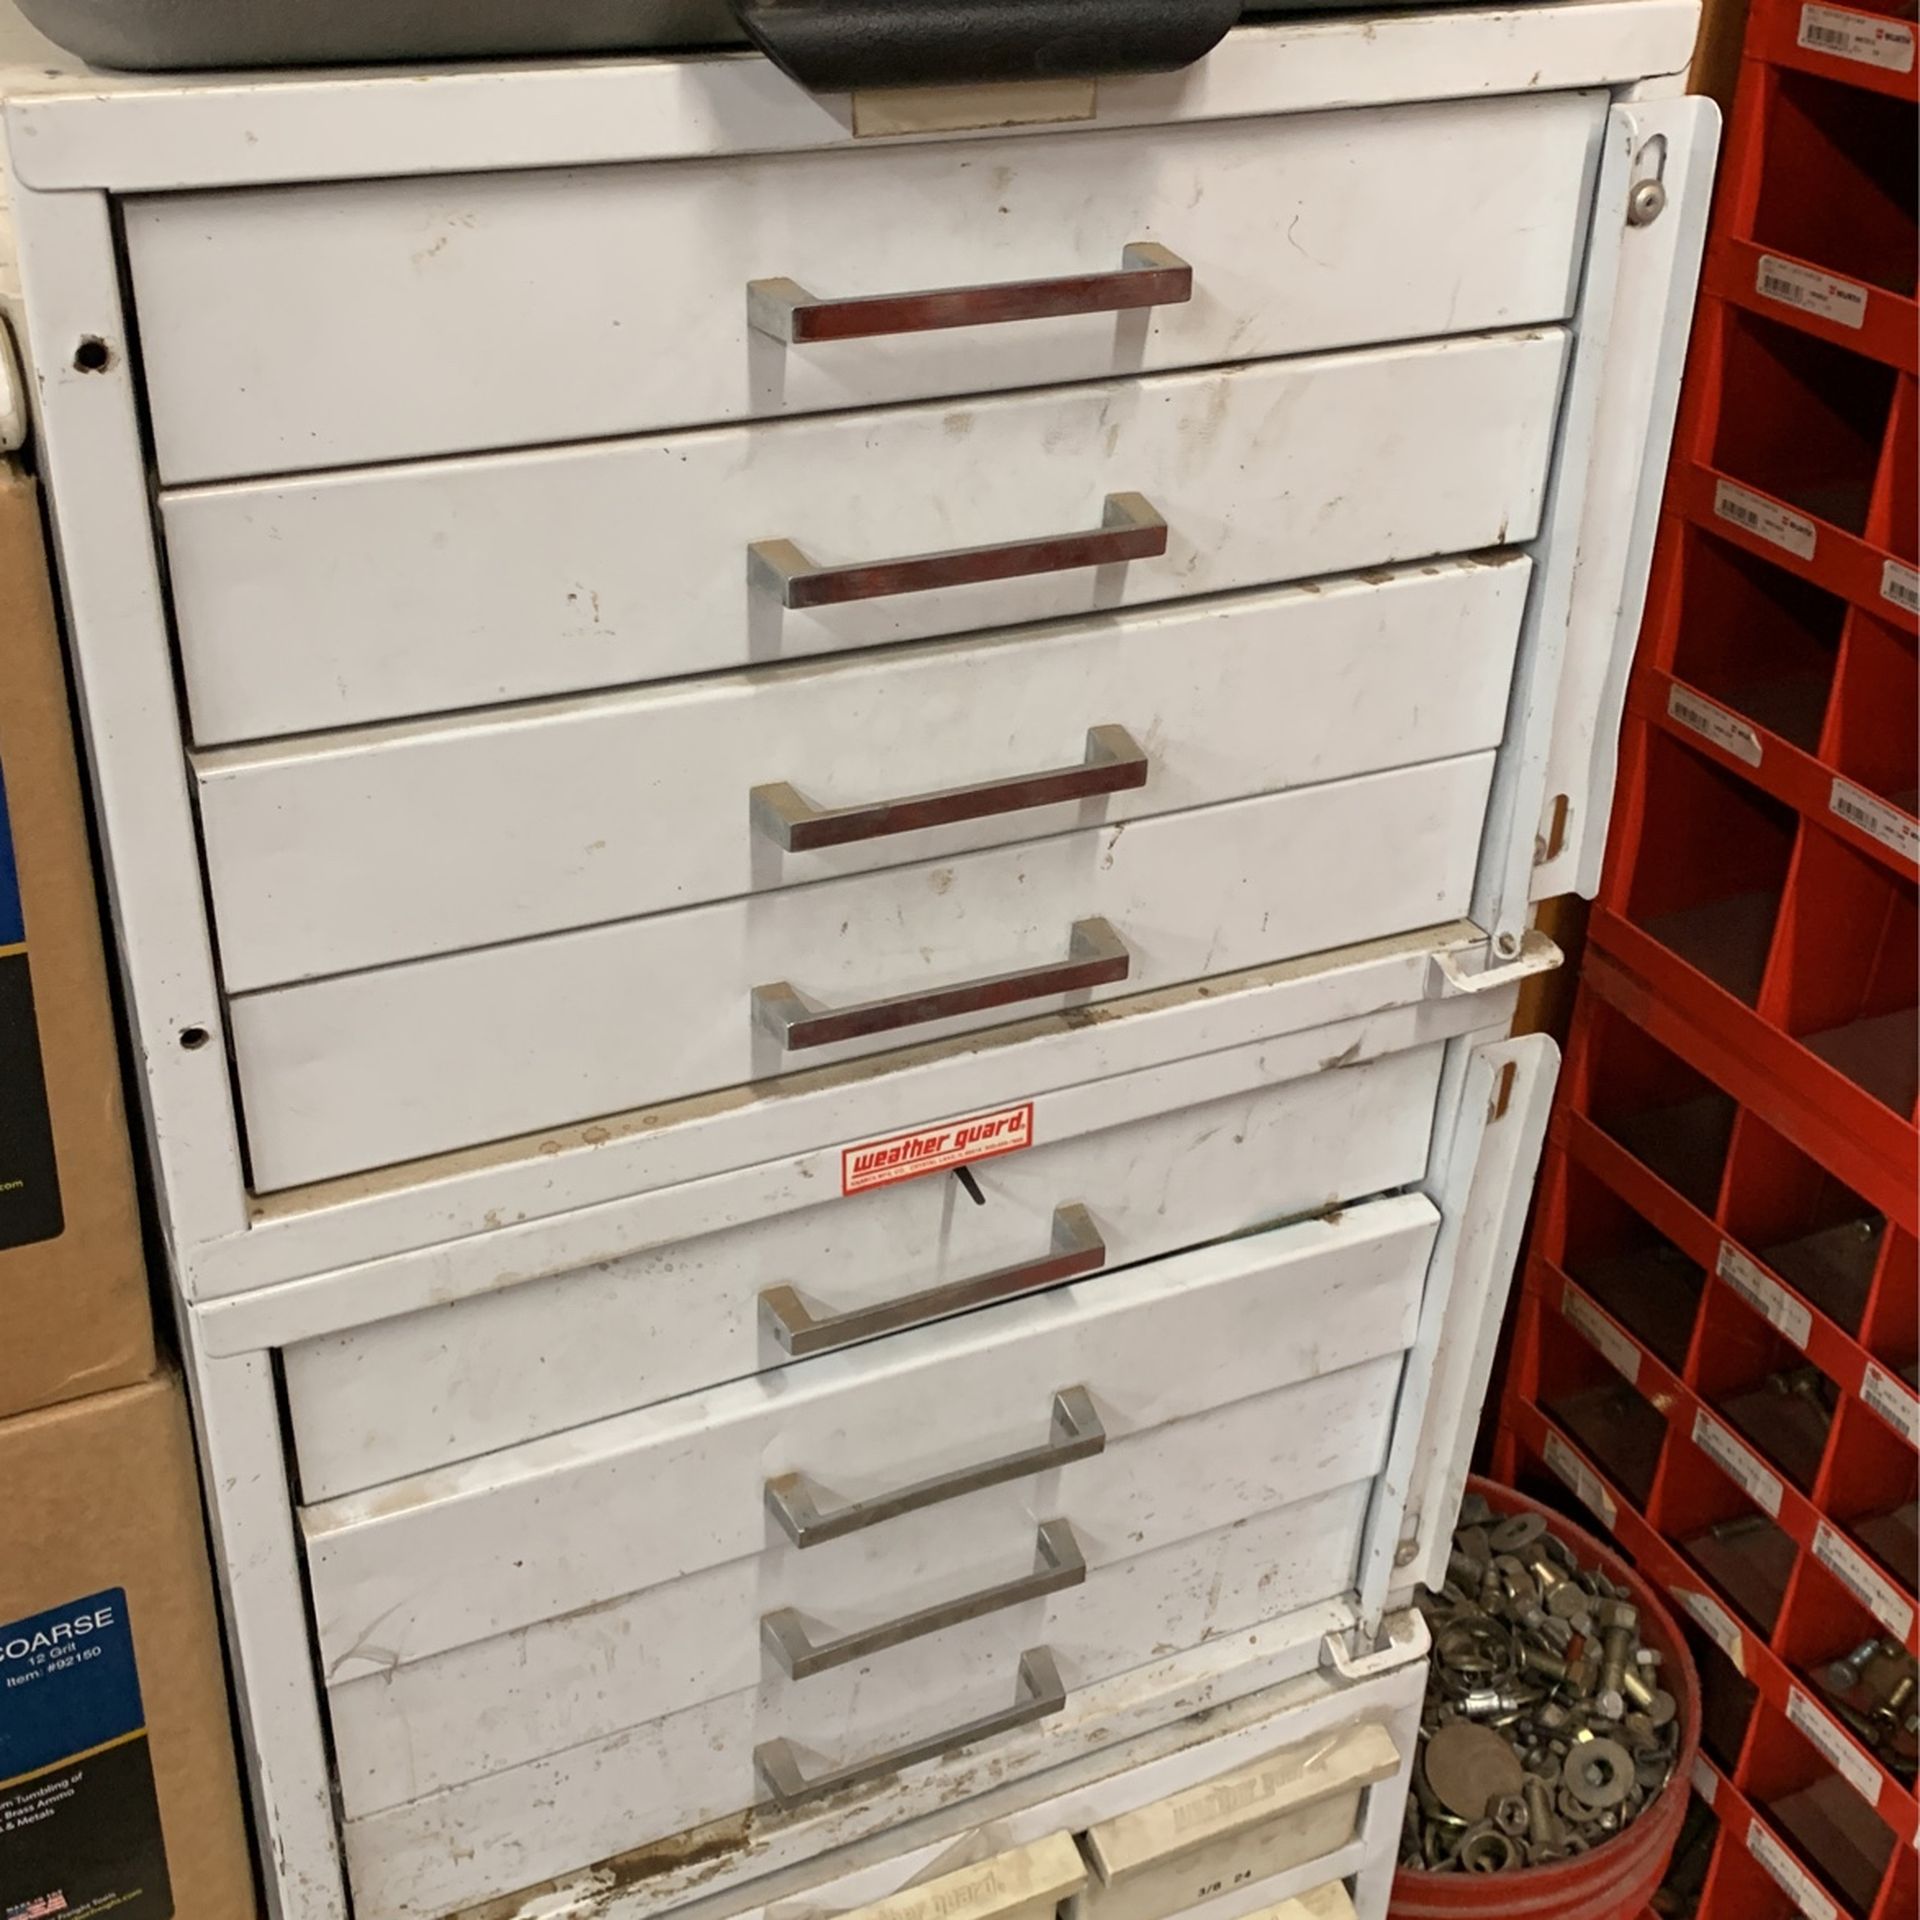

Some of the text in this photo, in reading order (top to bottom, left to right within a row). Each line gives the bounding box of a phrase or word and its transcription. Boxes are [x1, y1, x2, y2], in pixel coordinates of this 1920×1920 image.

[853, 1111, 1023, 1173] weather guard
[28, 1641, 77, 1666] 12 Grit
[15, 1771, 83, 1804] Tumbling of
[4, 1804, 36, 1820] Brass
[37, 1788, 76, 1808] Ammo
[17, 1808, 56, 1827] Metals
